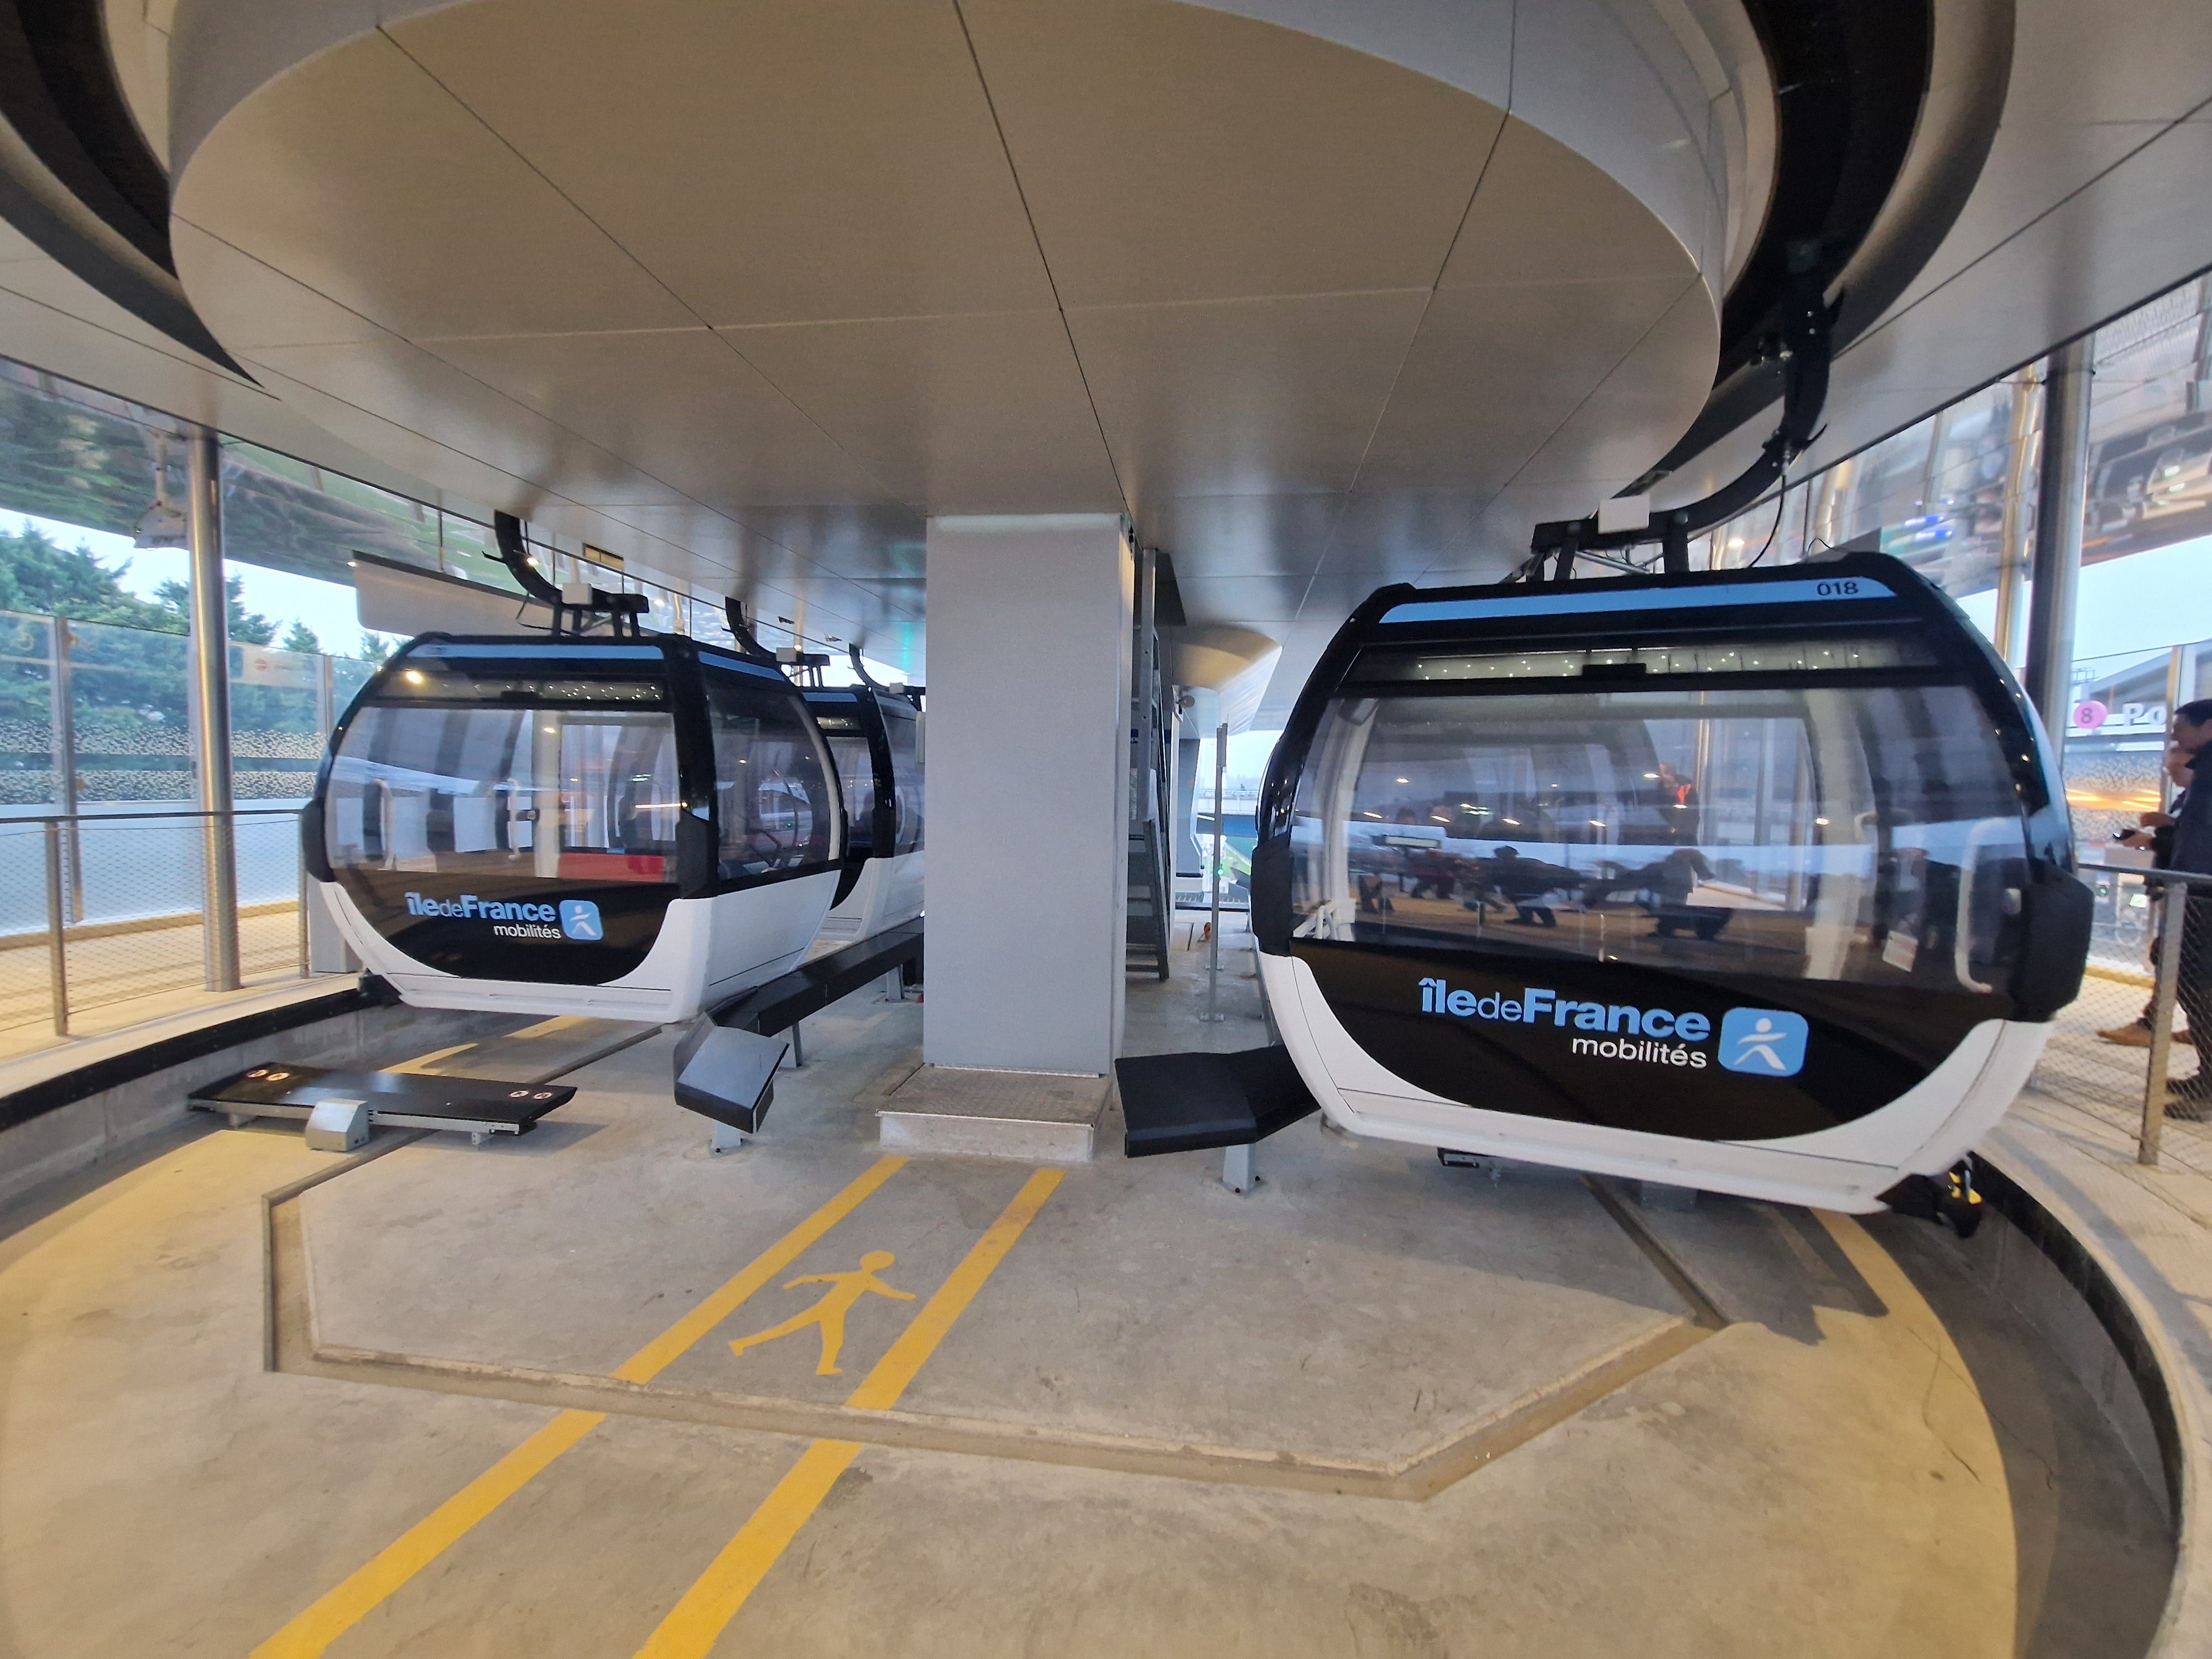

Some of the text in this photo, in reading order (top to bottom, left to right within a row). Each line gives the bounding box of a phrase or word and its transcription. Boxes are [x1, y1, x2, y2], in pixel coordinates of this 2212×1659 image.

[1817, 582, 1859, 596] 018
[2081, 708, 2093, 723] 8
[493, 924, 562, 939] mobilités
[1572, 1037, 1708, 1069] mobilités
